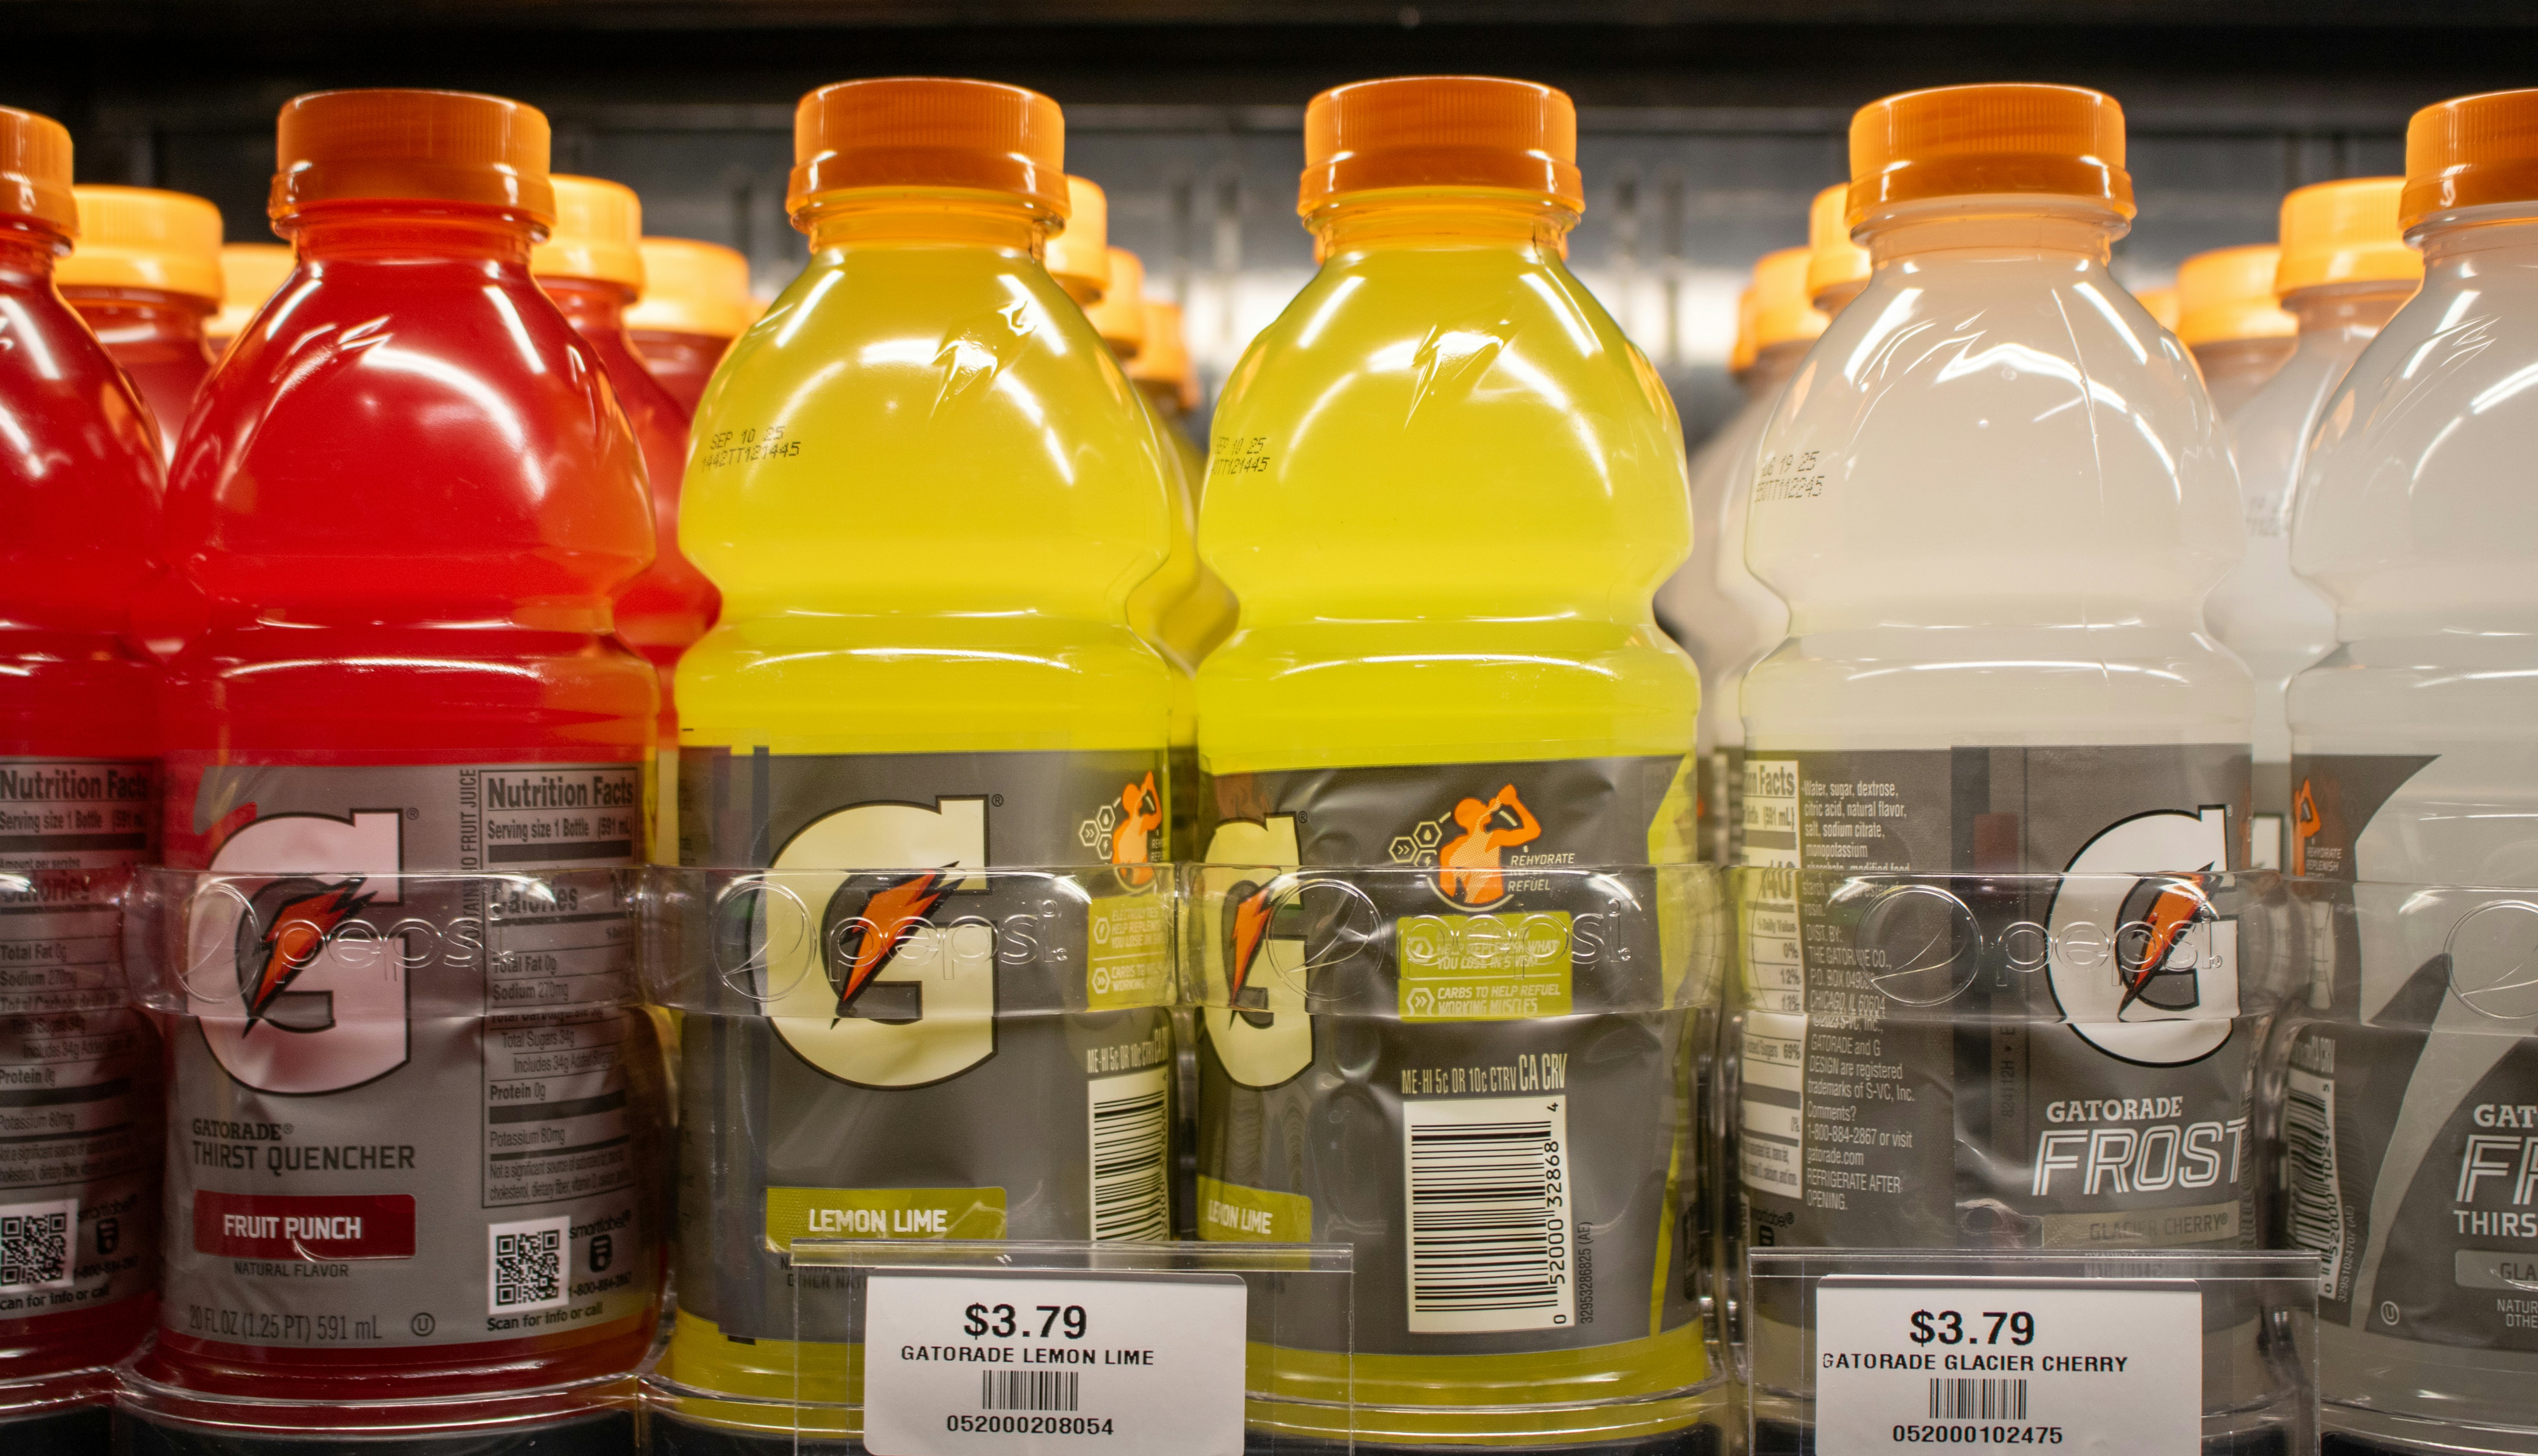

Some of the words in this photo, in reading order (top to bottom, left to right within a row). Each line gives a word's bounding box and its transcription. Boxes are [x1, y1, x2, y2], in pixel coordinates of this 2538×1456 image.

[742, 429, 755, 444] 10
[764, 426, 786, 442] 25
[1247, 437, 1267, 455] 25
[1797, 451, 1820, 473] 25
[0, 769, 102, 800] Nutrition
[459, 769, 477, 808] JUICE
[487, 775, 588, 808] Nutrition
[593, 775, 634, 806] Facts
[1759, 765, 1795, 796] Facts
[1829, 782, 1855, 799] sugar,
[1857, 780, 1898, 798] dextrose,
[0, 811, 41, 830] Serving
[44, 811, 65, 829] size
[1804, 800, 1823, 816] citric
[1824, 800, 1845, 818] acid,
[1847, 801, 1877, 817] natural
[1878, 800, 1907, 819] flavor,
[460, 811, 477, 852] FRUIT
[488, 820, 529, 842] Serving
[531, 820, 552, 838] size
[563, 818, 590, 837] Bottle
[1805, 822, 1821, 838] salt,
[1822, 821, 1852, 838] sodium
[1854, 821, 1885, 839] citrate,
[1511, 853, 1576, 867] REHYDRATE
[1806, 842, 1868, 860] monopotassium
[1508, 880, 1551, 893] REFUEL
[1806, 924, 1828, 942] DIST.
[0, 945, 31, 961] Total
[525, 956, 542, 971] Fat
[1437, 957, 1459, 970] YOU
[1807, 946, 1824, 964] THE
[1826, 947, 1871, 966] GATORDE
[1872, 950, 1892, 970] CO.,
[493, 983, 536, 1000] Sodium
[1438, 986, 1473, 999] CARBS
[1475, 986, 1488, 998] TO
[1491, 985, 1519, 997] HELP
[1520, 983, 1561, 997] REFUEL
[1438, 1000, 1488, 1016] WORKING
[1490, 998, 1538, 1015] MUSCLES
[1810, 990, 1846, 1013] CHICAGO,
[1858, 994, 1886, 1015] 60604
[502, 1031, 525, 1048] Total
[527, 1030, 558, 1050] Sugars
[559, 1028, 575, 1047] 34g
[1811, 1033, 1853, 1054] GATORADE
[1855, 1039, 1871, 1055] and
[1873, 1039, 1881, 1057] G
[513, 1057, 552, 1074] Includes
[552, 1055, 569, 1073] 34g
[1401, 1069, 1433, 1094] ME-HI
[1452, 1068, 1467, 1093] OR
[1489, 1066, 1517, 1092] CTRV
[1518, 1054, 1539, 1091] CA
[1542, 1052, 1568, 1090] CRV
[1809, 1055, 1839, 1075] DESIGN
[1840, 1062, 1854, 1076] are
[1855, 1063, 1903, 1081] registered
[0, 1069, 42, 1084] Protein
[489, 1082, 531, 1101] Protein
[534, 1082, 547, 1101] 0g
[1807, 1079, 1852, 1097] trademarks
[1854, 1082, 1864, 1098] of
[1866, 1083, 1894, 1103] S-VC,
[1896, 1084, 1914, 1102] Inc.
[1807, 1101, 1857, 1122] Comments?
[2046, 1096, 2184, 1123] GATORADE
[489, 1130, 540, 1148] Potassium
[541, 1127, 566, 1145] 80mg
[1807, 1123, 1877, 1144] 1-800-884-2867
[1879, 1132, 1890, 1146] or
[1892, 1131, 1913, 1148] visit
[193, 1141, 262, 1170] THIRST
[267, 1145, 416, 1176] QUENCHER
[1807, 1147, 1865, 1166] gatorade.com
[2031, 1116, 2247, 1196] FROST
[489, 1162, 504, 1179] Not
[1544, 1140, 1563, 1208] 32868
[1807, 1167, 1867, 1191] REFRIGERATE
[1869, 1173, 1901, 1194] AFTER
[1807, 1189, 1849, 1211] OPENING.
[223, 1214, 280, 1239] FRUIT
[284, 1216, 363, 1240] PUNCH
[809, 1209, 887, 1233] LEMON
[894, 1209, 948, 1233] LIME
[1241, 1208, 1273, 1235] LIME
[1577, 1220, 1594, 1246] (AE)
[1546, 1218, 1566, 1285] 52000
[234, 1261, 289, 1278] NATURAL
[293, 1261, 349, 1278] FLAVOR
[1577, 1247, 1594, 1324] 32953286825
[27, 1295, 46, 1307] for
[77, 1289, 88, 1300] or
[204, 1308, 219, 1333] FL
[221, 1309, 240, 1336] OZ
[242, 1310, 280, 1340] (1.25
[283, 1314, 311, 1342] PT)
[317, 1314, 348, 1341] 591
[355, 1313, 383, 1341] mL
[487, 1317, 519, 1332] Scan
[522, 1311, 542, 1328] for
[545, 1307, 568, 1325] info
[571, 1305, 585, 1320] or
[585, 1302, 604, 1319] call
[964, 1302, 1088, 1340] $3.79
[1910, 1309, 2035, 1347] $3.79
[901, 1346, 1015, 1363] GATORADE
[1024, 1348, 1096, 1365] LEMON
[1104, 1349, 1155, 1366] LIME
[1822, 1353, 1936, 1371] GATORADE
[1945, 1355, 2034, 1371] GLACIER
[2042, 1355, 2128, 1373] CHERRY
[947, 1415, 1114, 1436] 052000208054
[1893, 1425, 2063, 1444] 052000102475
